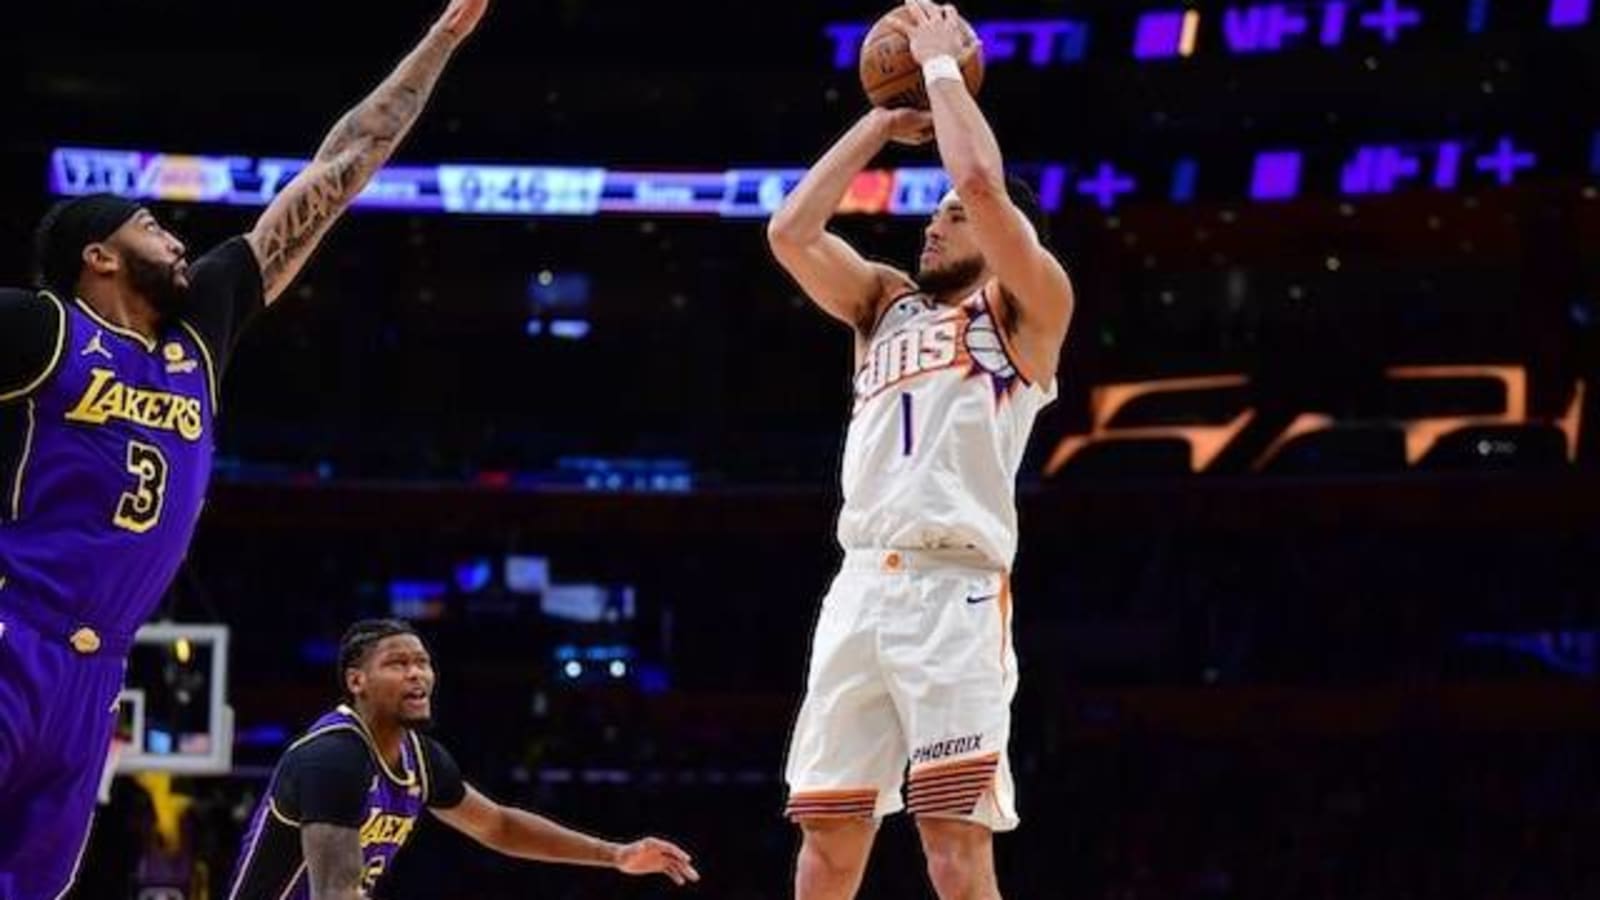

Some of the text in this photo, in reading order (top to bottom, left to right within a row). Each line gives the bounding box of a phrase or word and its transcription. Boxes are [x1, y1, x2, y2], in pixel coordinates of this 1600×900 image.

[64, 368, 203, 441] LAKERS
[901, 392, 913, 456] 1
[113, 440, 168, 533] 3
[913, 733, 983, 761] PHOENIX
